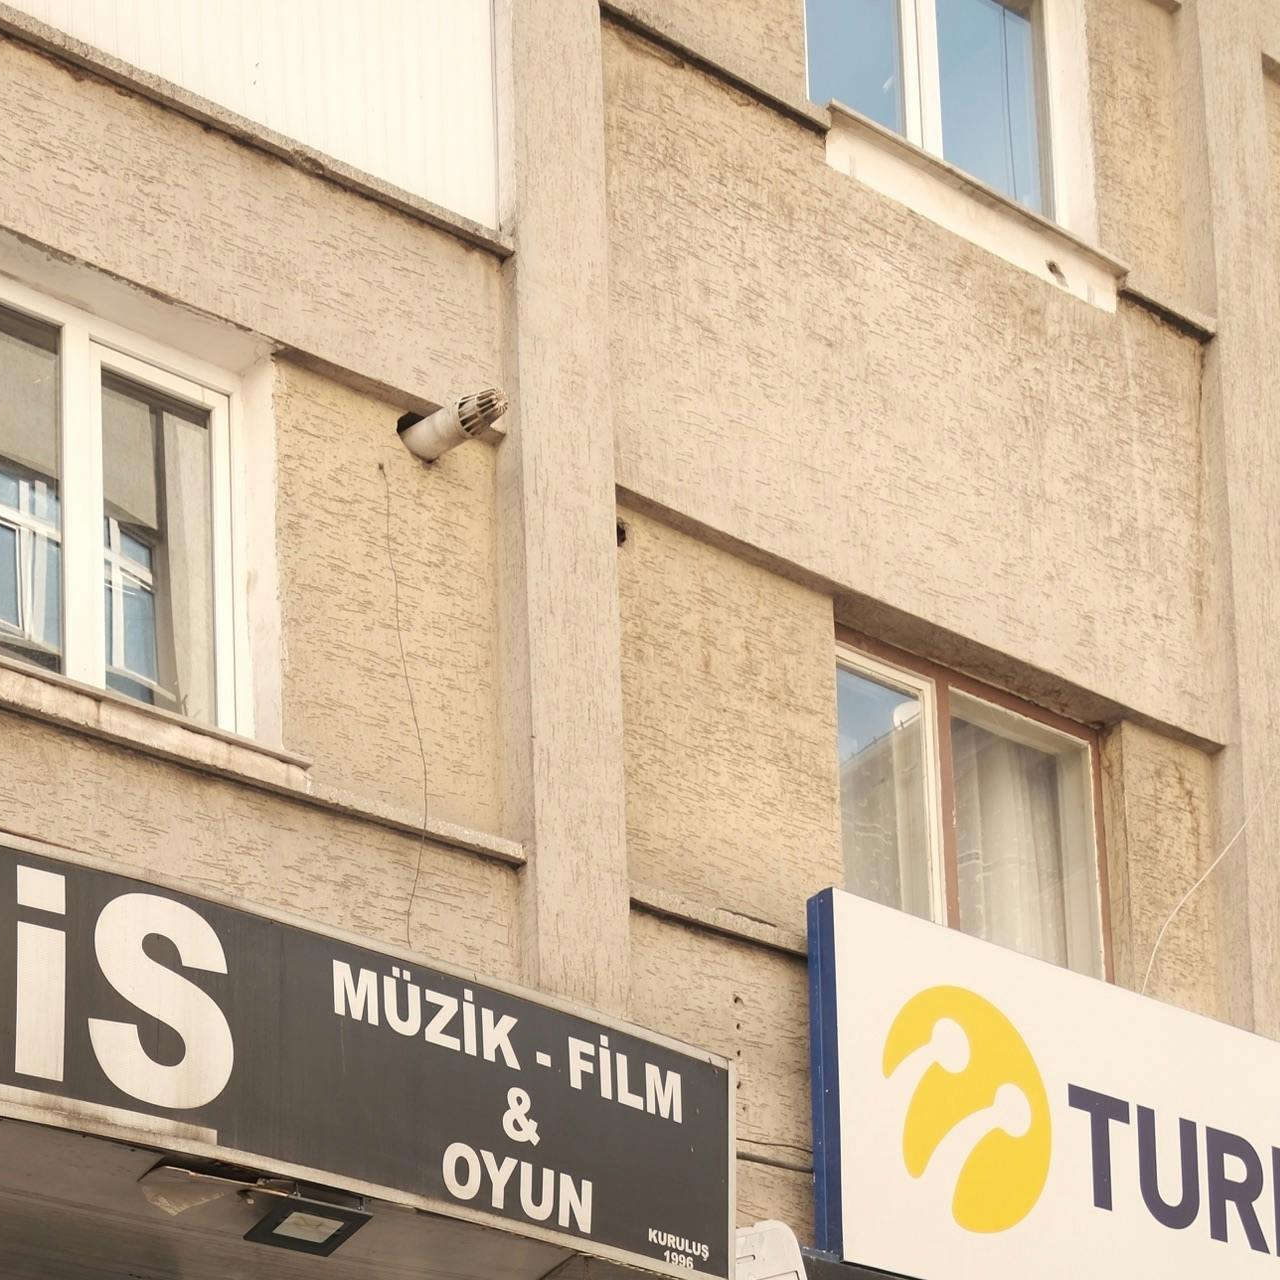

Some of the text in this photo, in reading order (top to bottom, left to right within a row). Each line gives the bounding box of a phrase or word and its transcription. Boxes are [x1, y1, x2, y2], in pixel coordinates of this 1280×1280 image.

[332, 959, 521, 1071] MÜZİK
[568, 1034, 683, 1124] FİLM
[502, 1086, 541, 1147] &
[442, 1141, 593, 1234] OYUN
[1067, 1083, 1280, 1257] TUR
[648, 1228, 709, 1261] KURULUŞ
[663, 1250, 694, 1270] 1996
